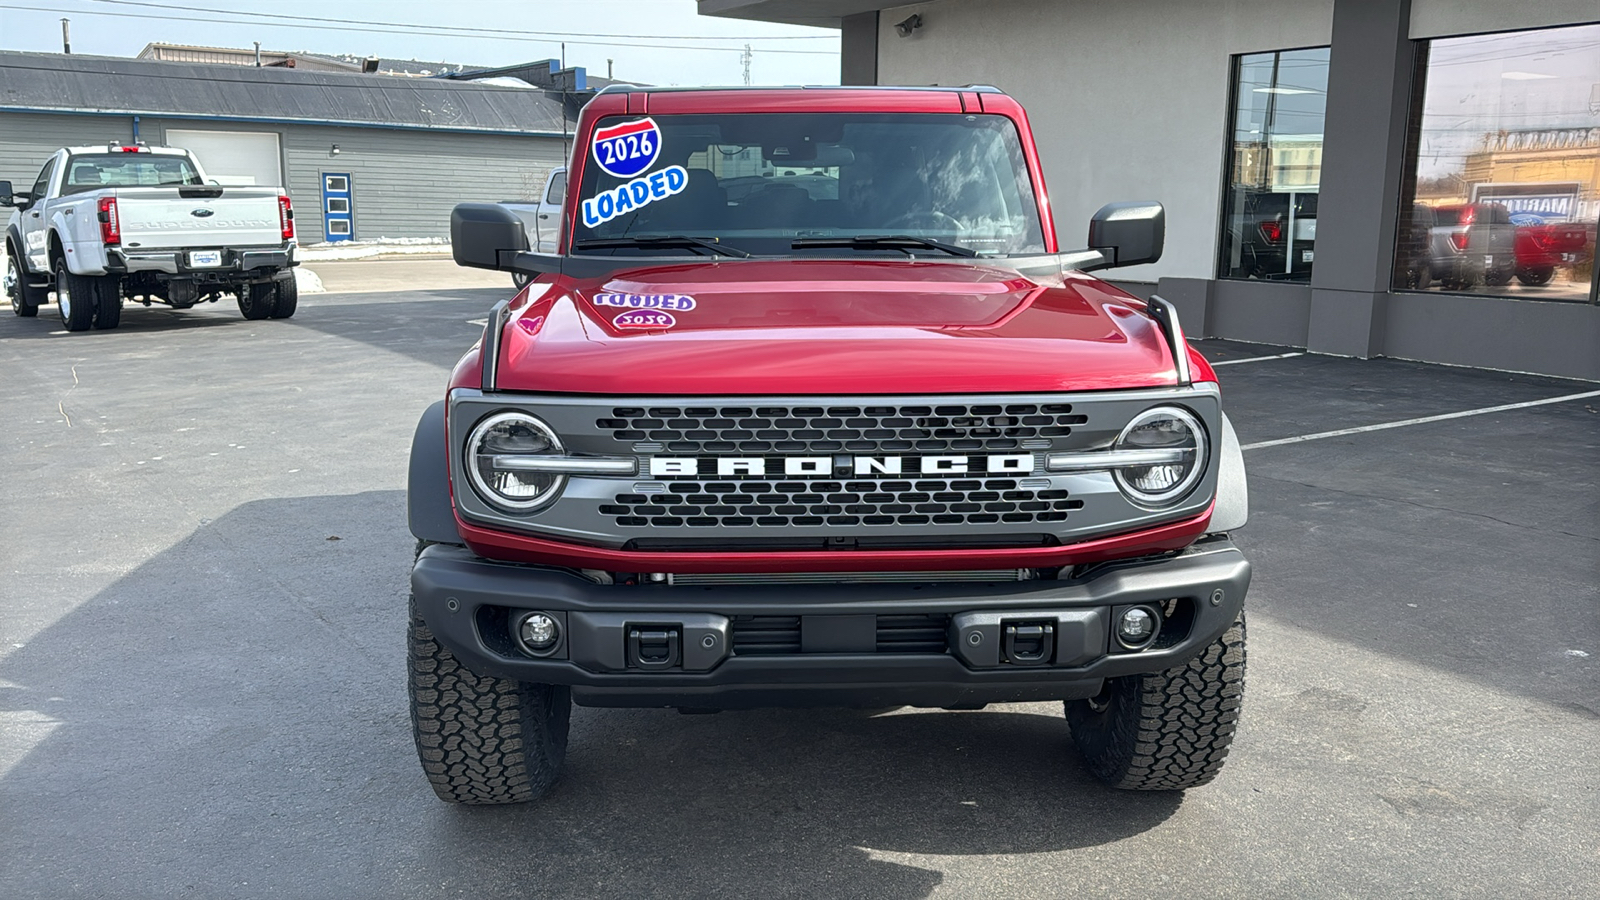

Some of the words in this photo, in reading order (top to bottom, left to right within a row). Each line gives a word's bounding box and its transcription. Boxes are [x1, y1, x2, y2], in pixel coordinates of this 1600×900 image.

[602, 132, 653, 165] 2026
[584, 168, 685, 226] LOADED
[129, 220, 210, 229] SUPER
[215, 219, 273, 228] DUTY
[650, 454, 1035, 476] BRONCO
